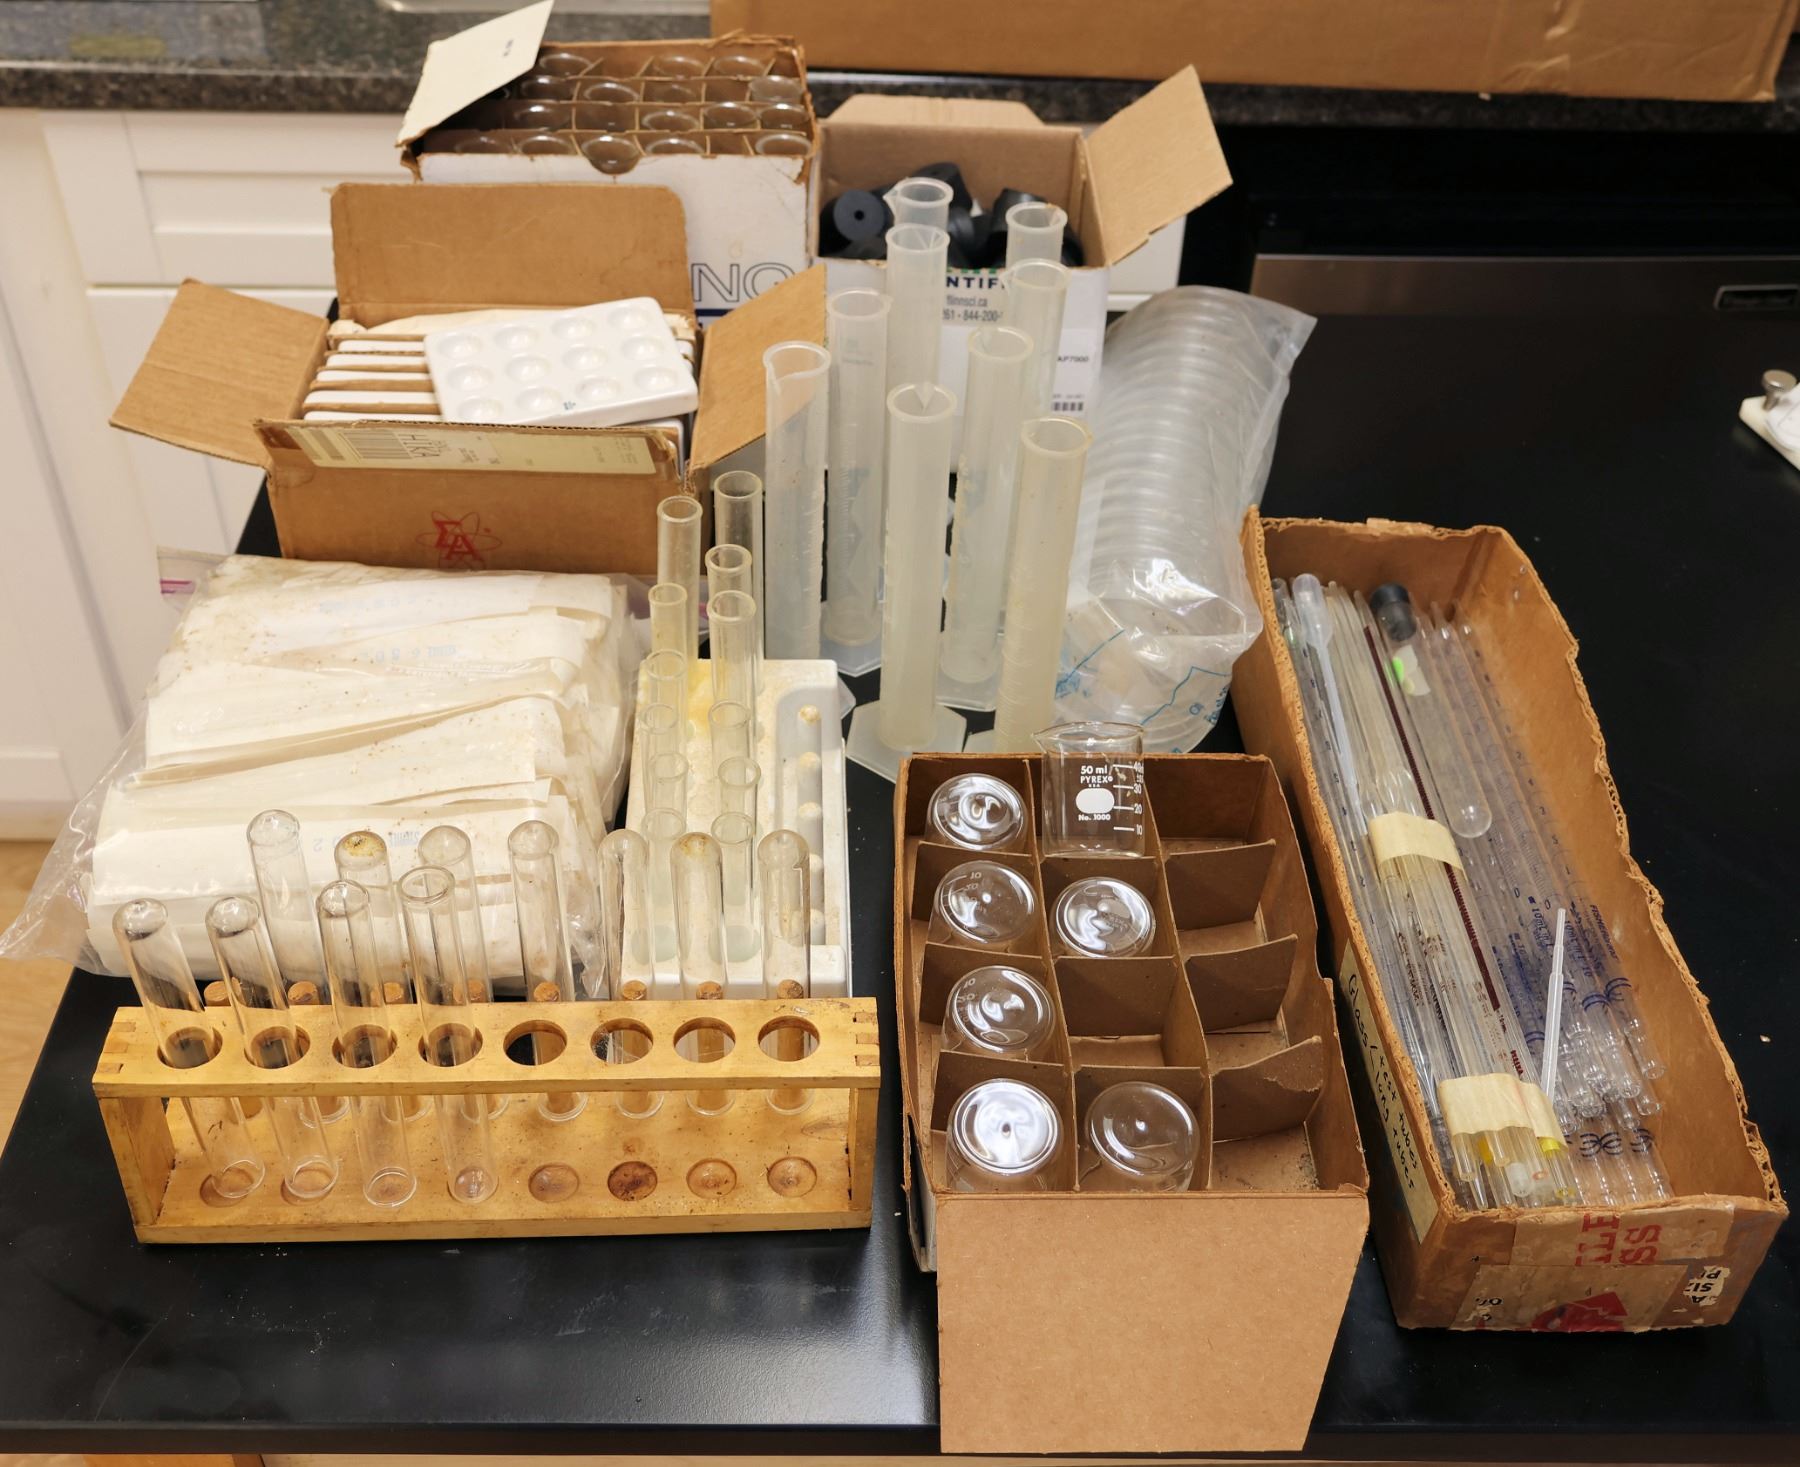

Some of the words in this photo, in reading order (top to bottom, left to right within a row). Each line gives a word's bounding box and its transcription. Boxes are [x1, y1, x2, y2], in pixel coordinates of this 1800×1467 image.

[1081, 765, 1094, 775] 50
[1096, 764, 1108, 775] ml
[1135, 803, 1143, 815] 20
[1136, 824, 1143, 836] 10
